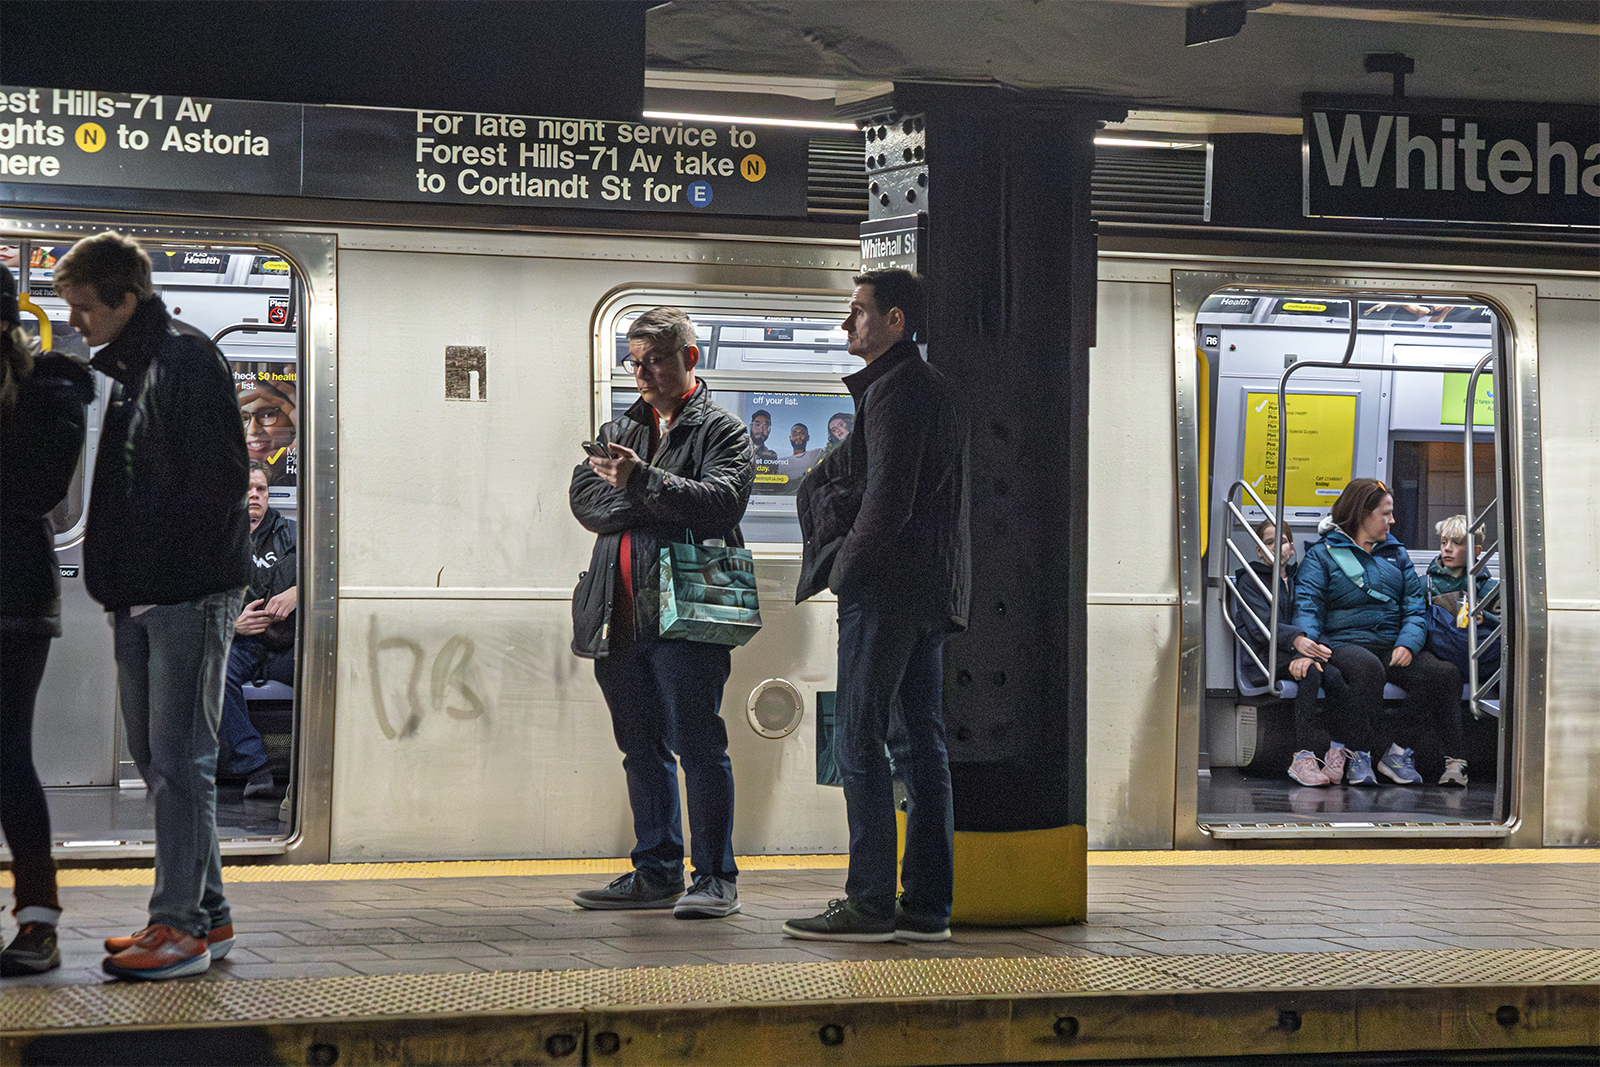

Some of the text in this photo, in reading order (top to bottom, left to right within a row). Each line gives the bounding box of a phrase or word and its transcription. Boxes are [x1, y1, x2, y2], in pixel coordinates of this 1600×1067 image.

[52, 89, 163, 120] Hills-71
[175, 97, 213, 122] Av
[0, 117, 270, 156] ghts N to Astoria
[416, 110, 757, 149] For late night service to
[416, 138, 760, 177] Forest Hills-71 Av take N
[416, 168, 707, 203] to Cortlandt St for E
[861, 233, 915, 259] Whitehall St
[184, 256, 220, 265] Health
[1220, 298, 1250, 306] Health
[1206, 336, 1218, 346] R6
[232, 372, 256, 380] heck
[258, 371, 271, 382] $0
[241, 381, 257, 390] list.
[752, 396, 799, 407] off your list.
